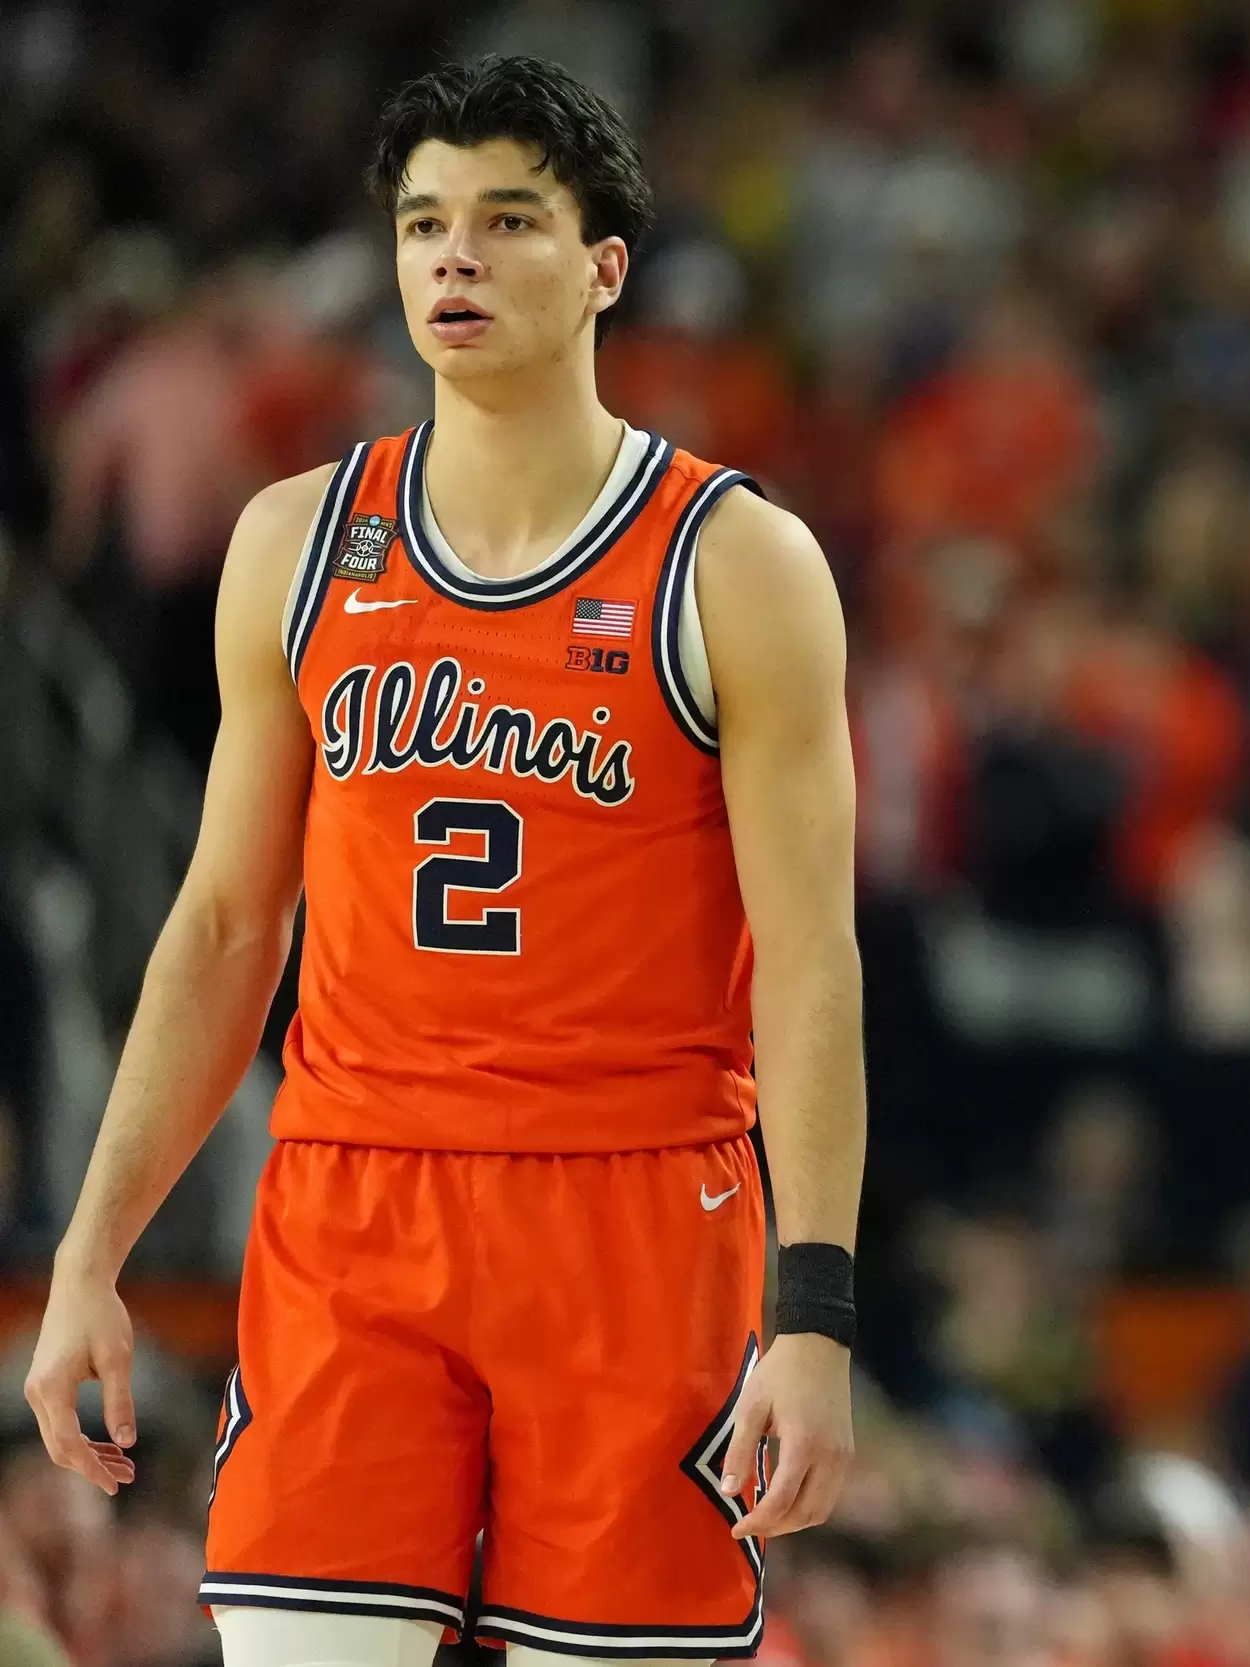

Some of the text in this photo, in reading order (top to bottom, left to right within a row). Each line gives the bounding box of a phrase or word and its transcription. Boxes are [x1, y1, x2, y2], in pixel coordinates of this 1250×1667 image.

[340, 553, 377, 570] FOUR
[350, 526, 388, 543] FINAL
[321, 656, 635, 807] Illinois
[412, 796, 524, 956] 2
